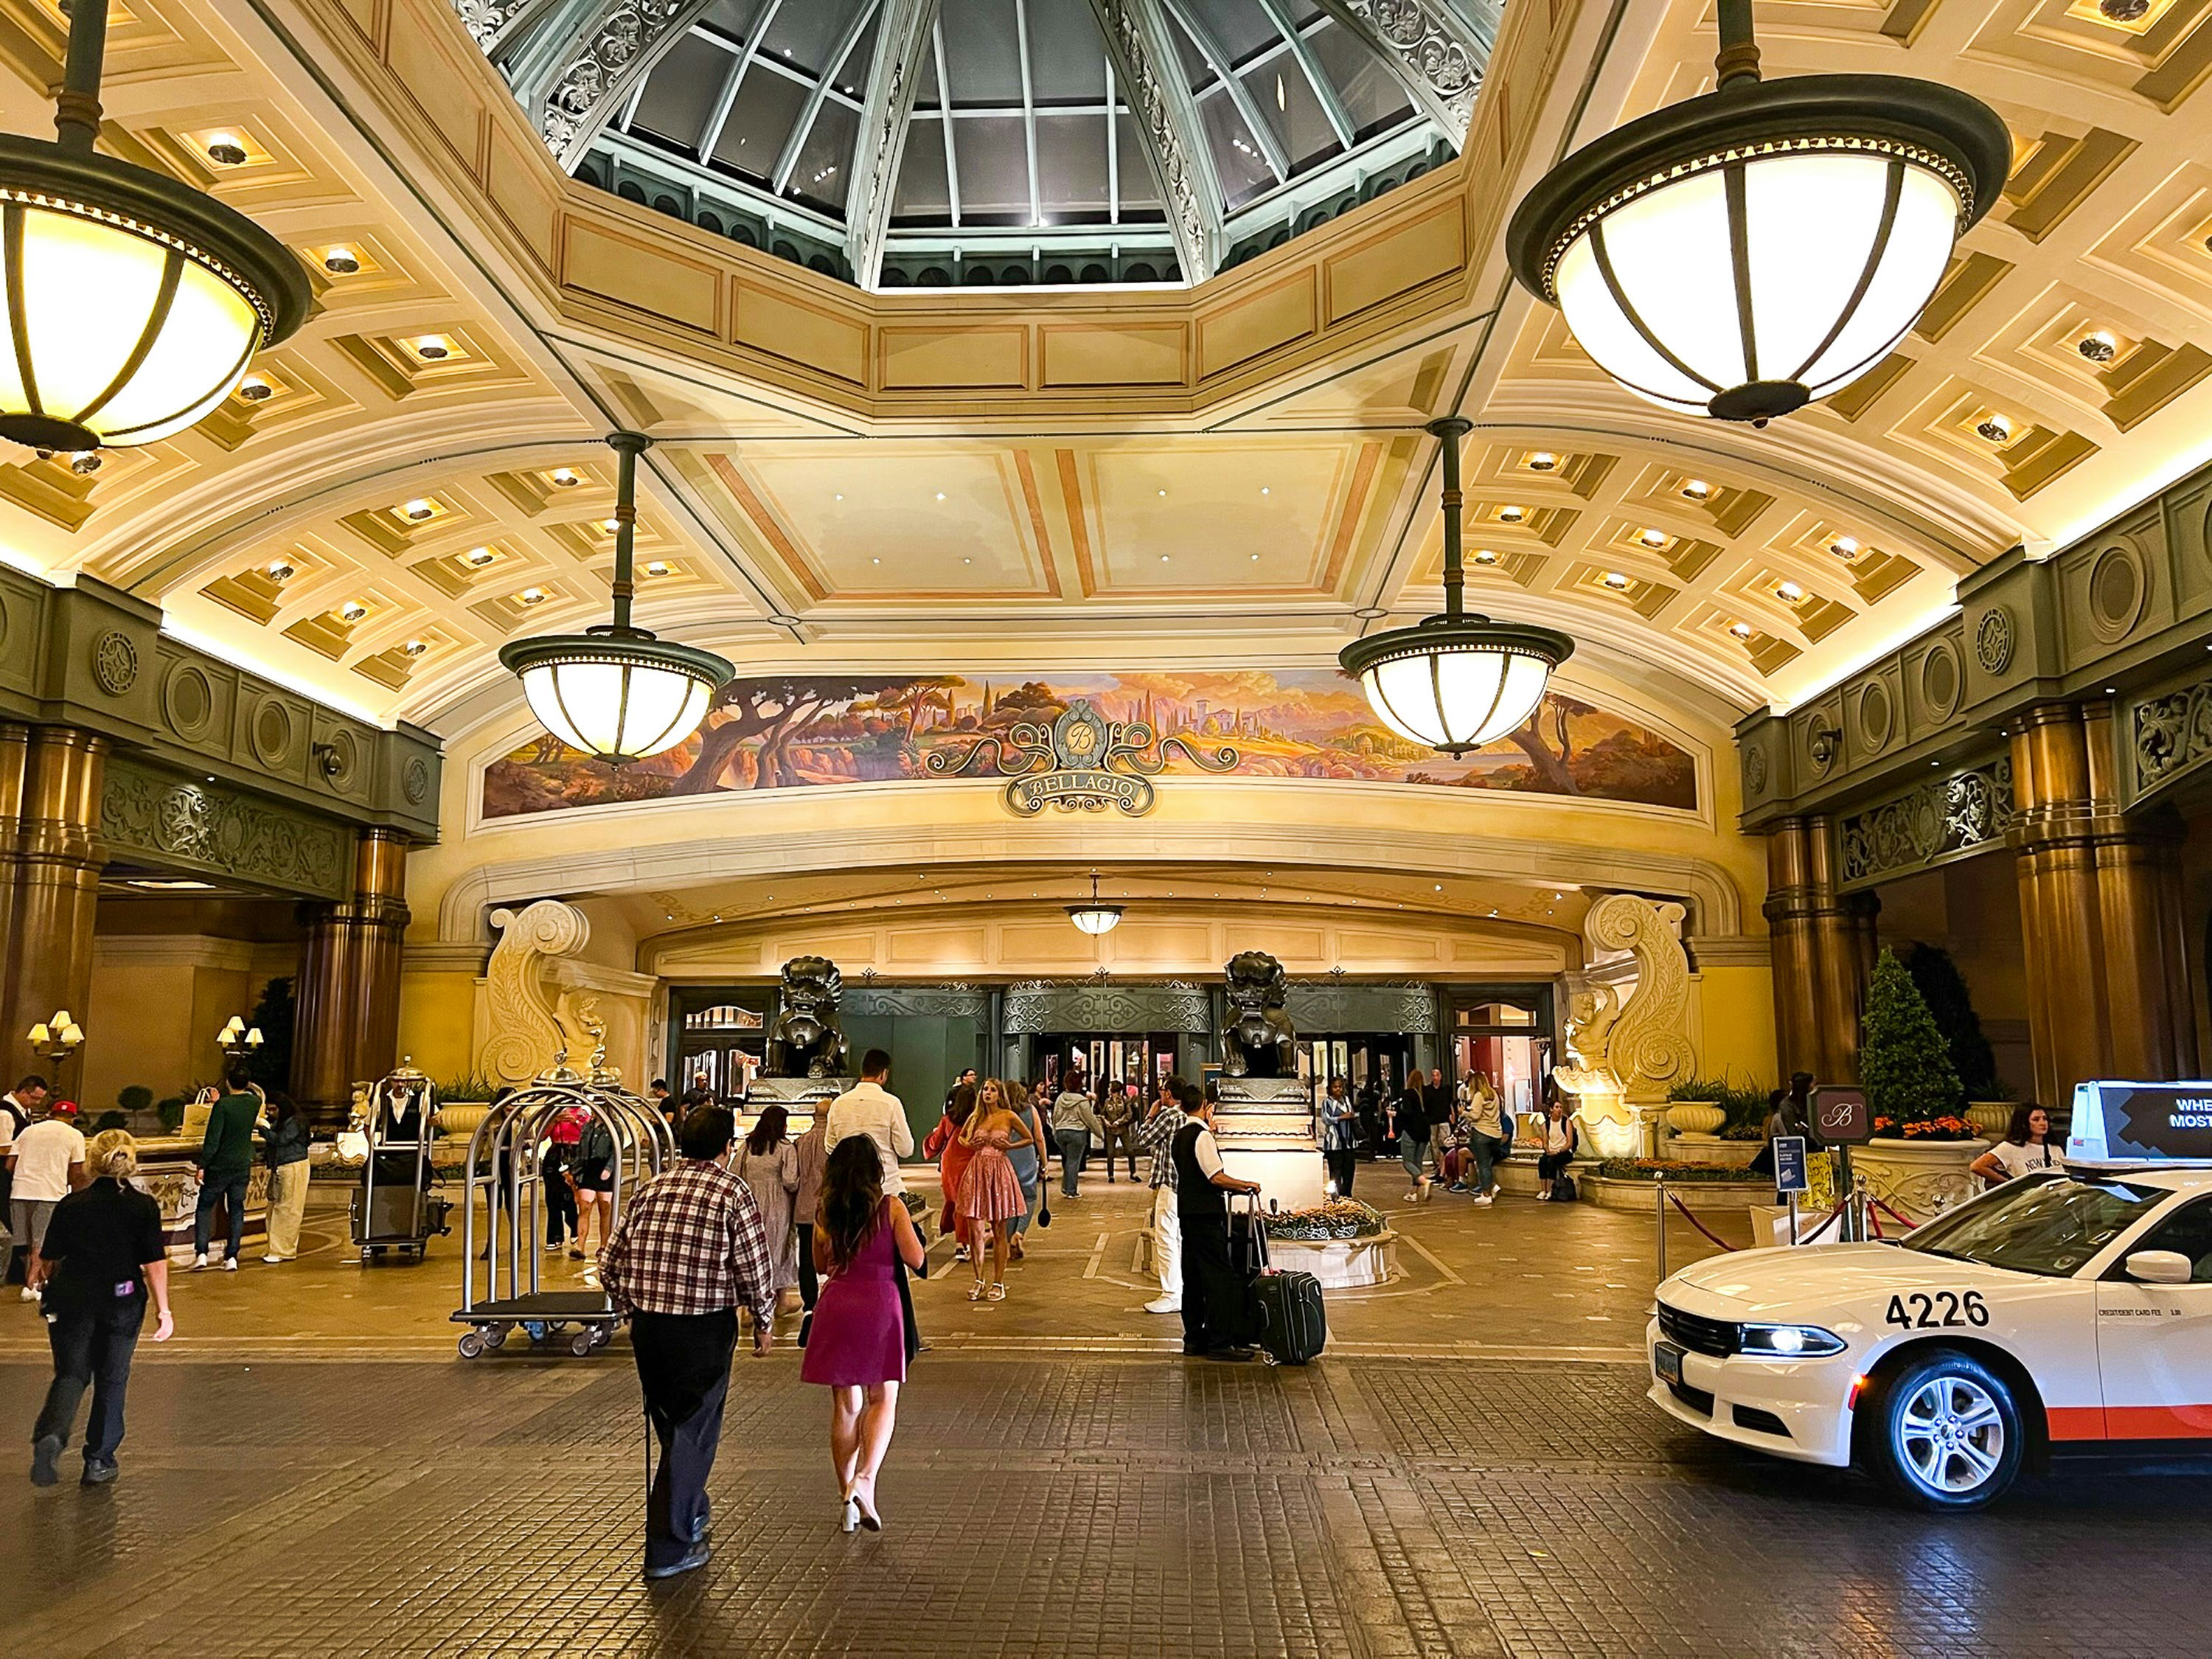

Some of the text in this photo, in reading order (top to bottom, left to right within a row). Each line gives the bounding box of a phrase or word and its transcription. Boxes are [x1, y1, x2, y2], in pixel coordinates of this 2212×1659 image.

[1068, 724, 1093, 750] B
[1029, 775, 1133, 796] BELLAGIO
[1821, 1103, 1863, 1127] B
[2176, 1099, 2212, 1112] WHE
[2169, 1113, 2212, 1128] MOST
[1886, 1290, 1989, 1329] 4226
